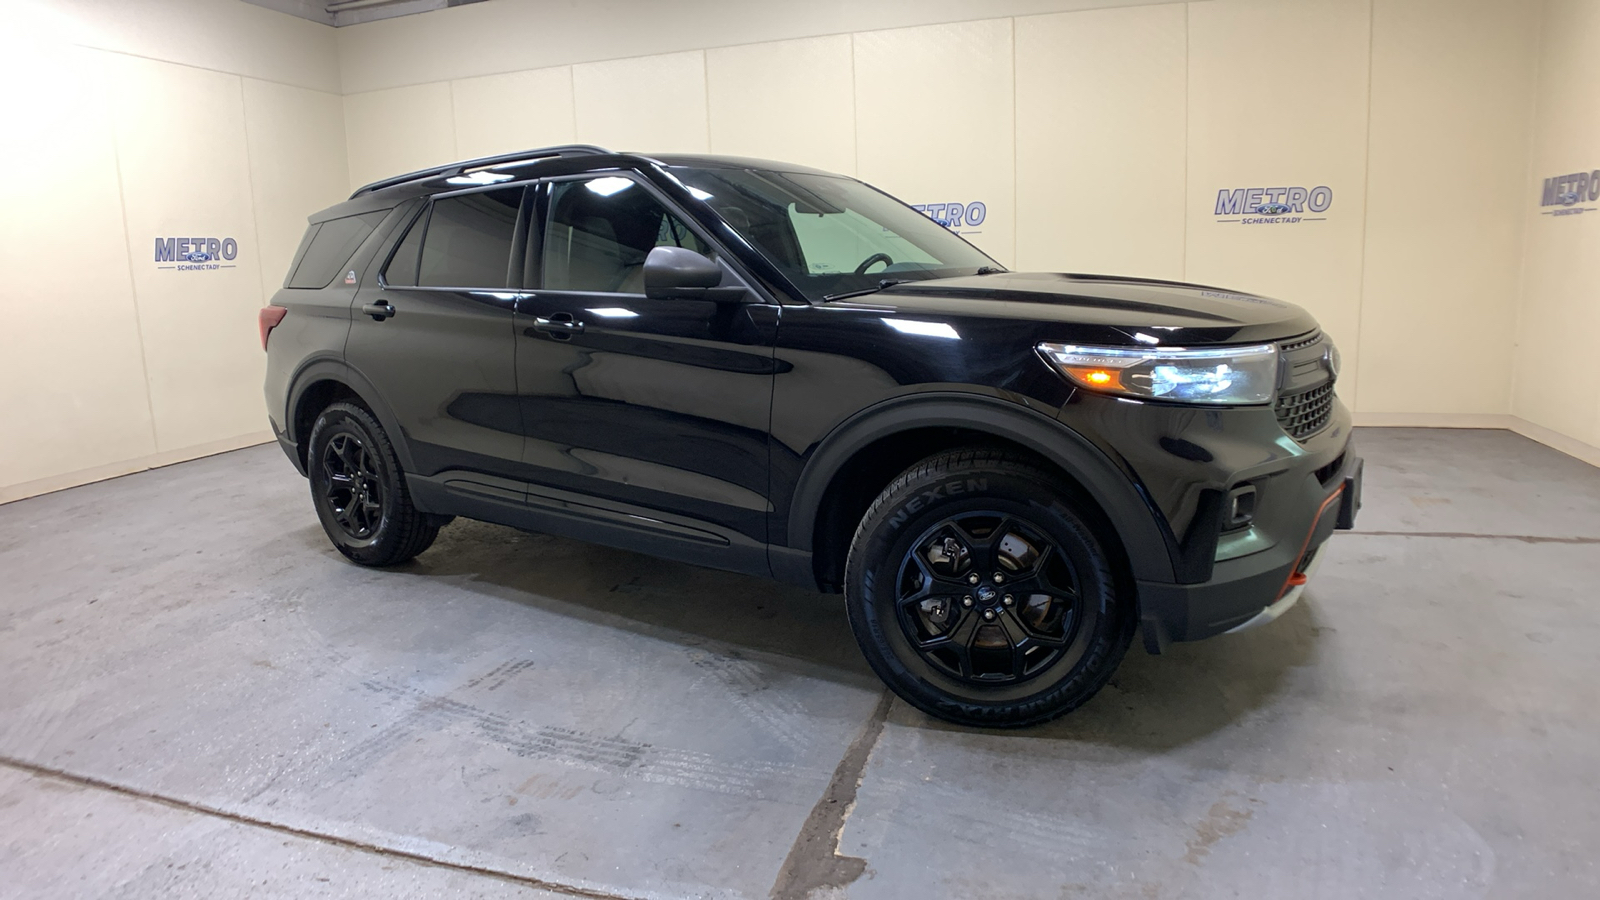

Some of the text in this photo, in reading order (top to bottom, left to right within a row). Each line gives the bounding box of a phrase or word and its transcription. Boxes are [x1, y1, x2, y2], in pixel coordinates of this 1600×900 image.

[1214, 186, 1333, 215] METRO
[1541, 169, 1600, 206] METRO
[911, 201, 987, 227] TRO
[155, 237, 238, 262] METRO
[889, 478, 988, 530] NEXEN
